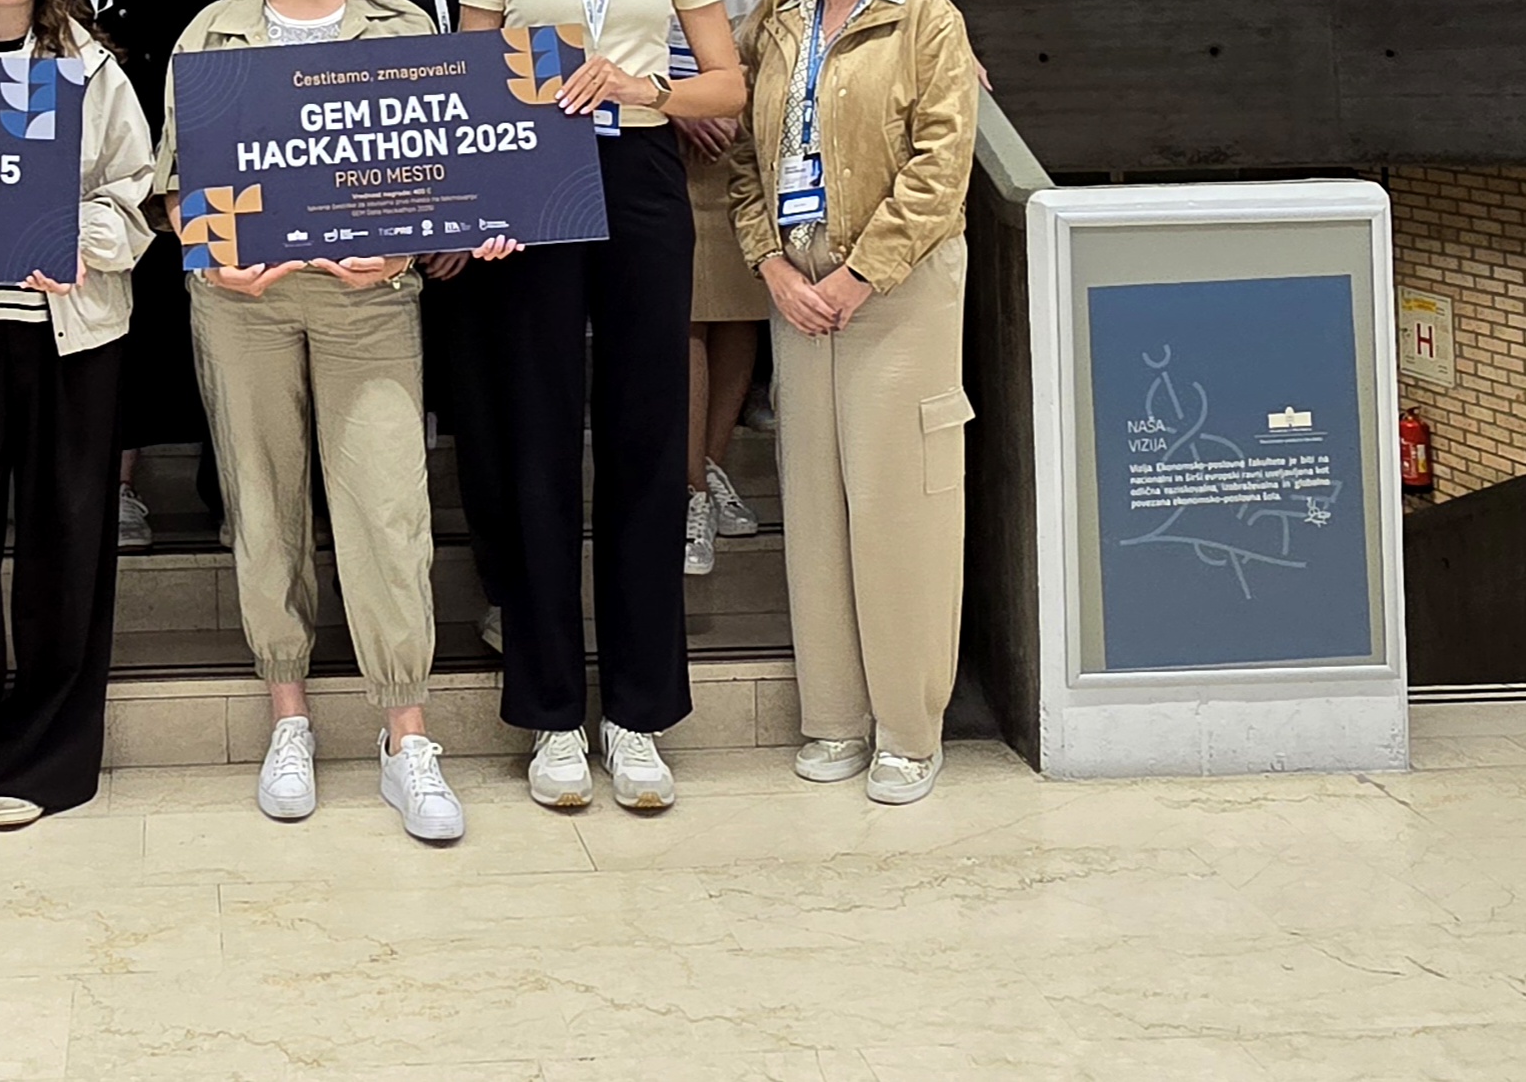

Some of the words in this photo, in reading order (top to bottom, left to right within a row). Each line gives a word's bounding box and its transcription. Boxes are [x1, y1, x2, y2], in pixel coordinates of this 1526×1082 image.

[293, 68, 373, 87] Čestitamo,
[377, 61, 467, 82] zmagovalci!
[300, 98, 372, 132] GEM
[379, 92, 469, 126] DATA
[237, 126, 450, 172] HACKATHON
[455, 121, 538, 155] 2025
[335, 168, 382, 188] PRVO
[386, 163, 446, 184] MESTO
[1417, 323, 1434, 358] H
[1128, 437, 1167, 453] VIZIJA
